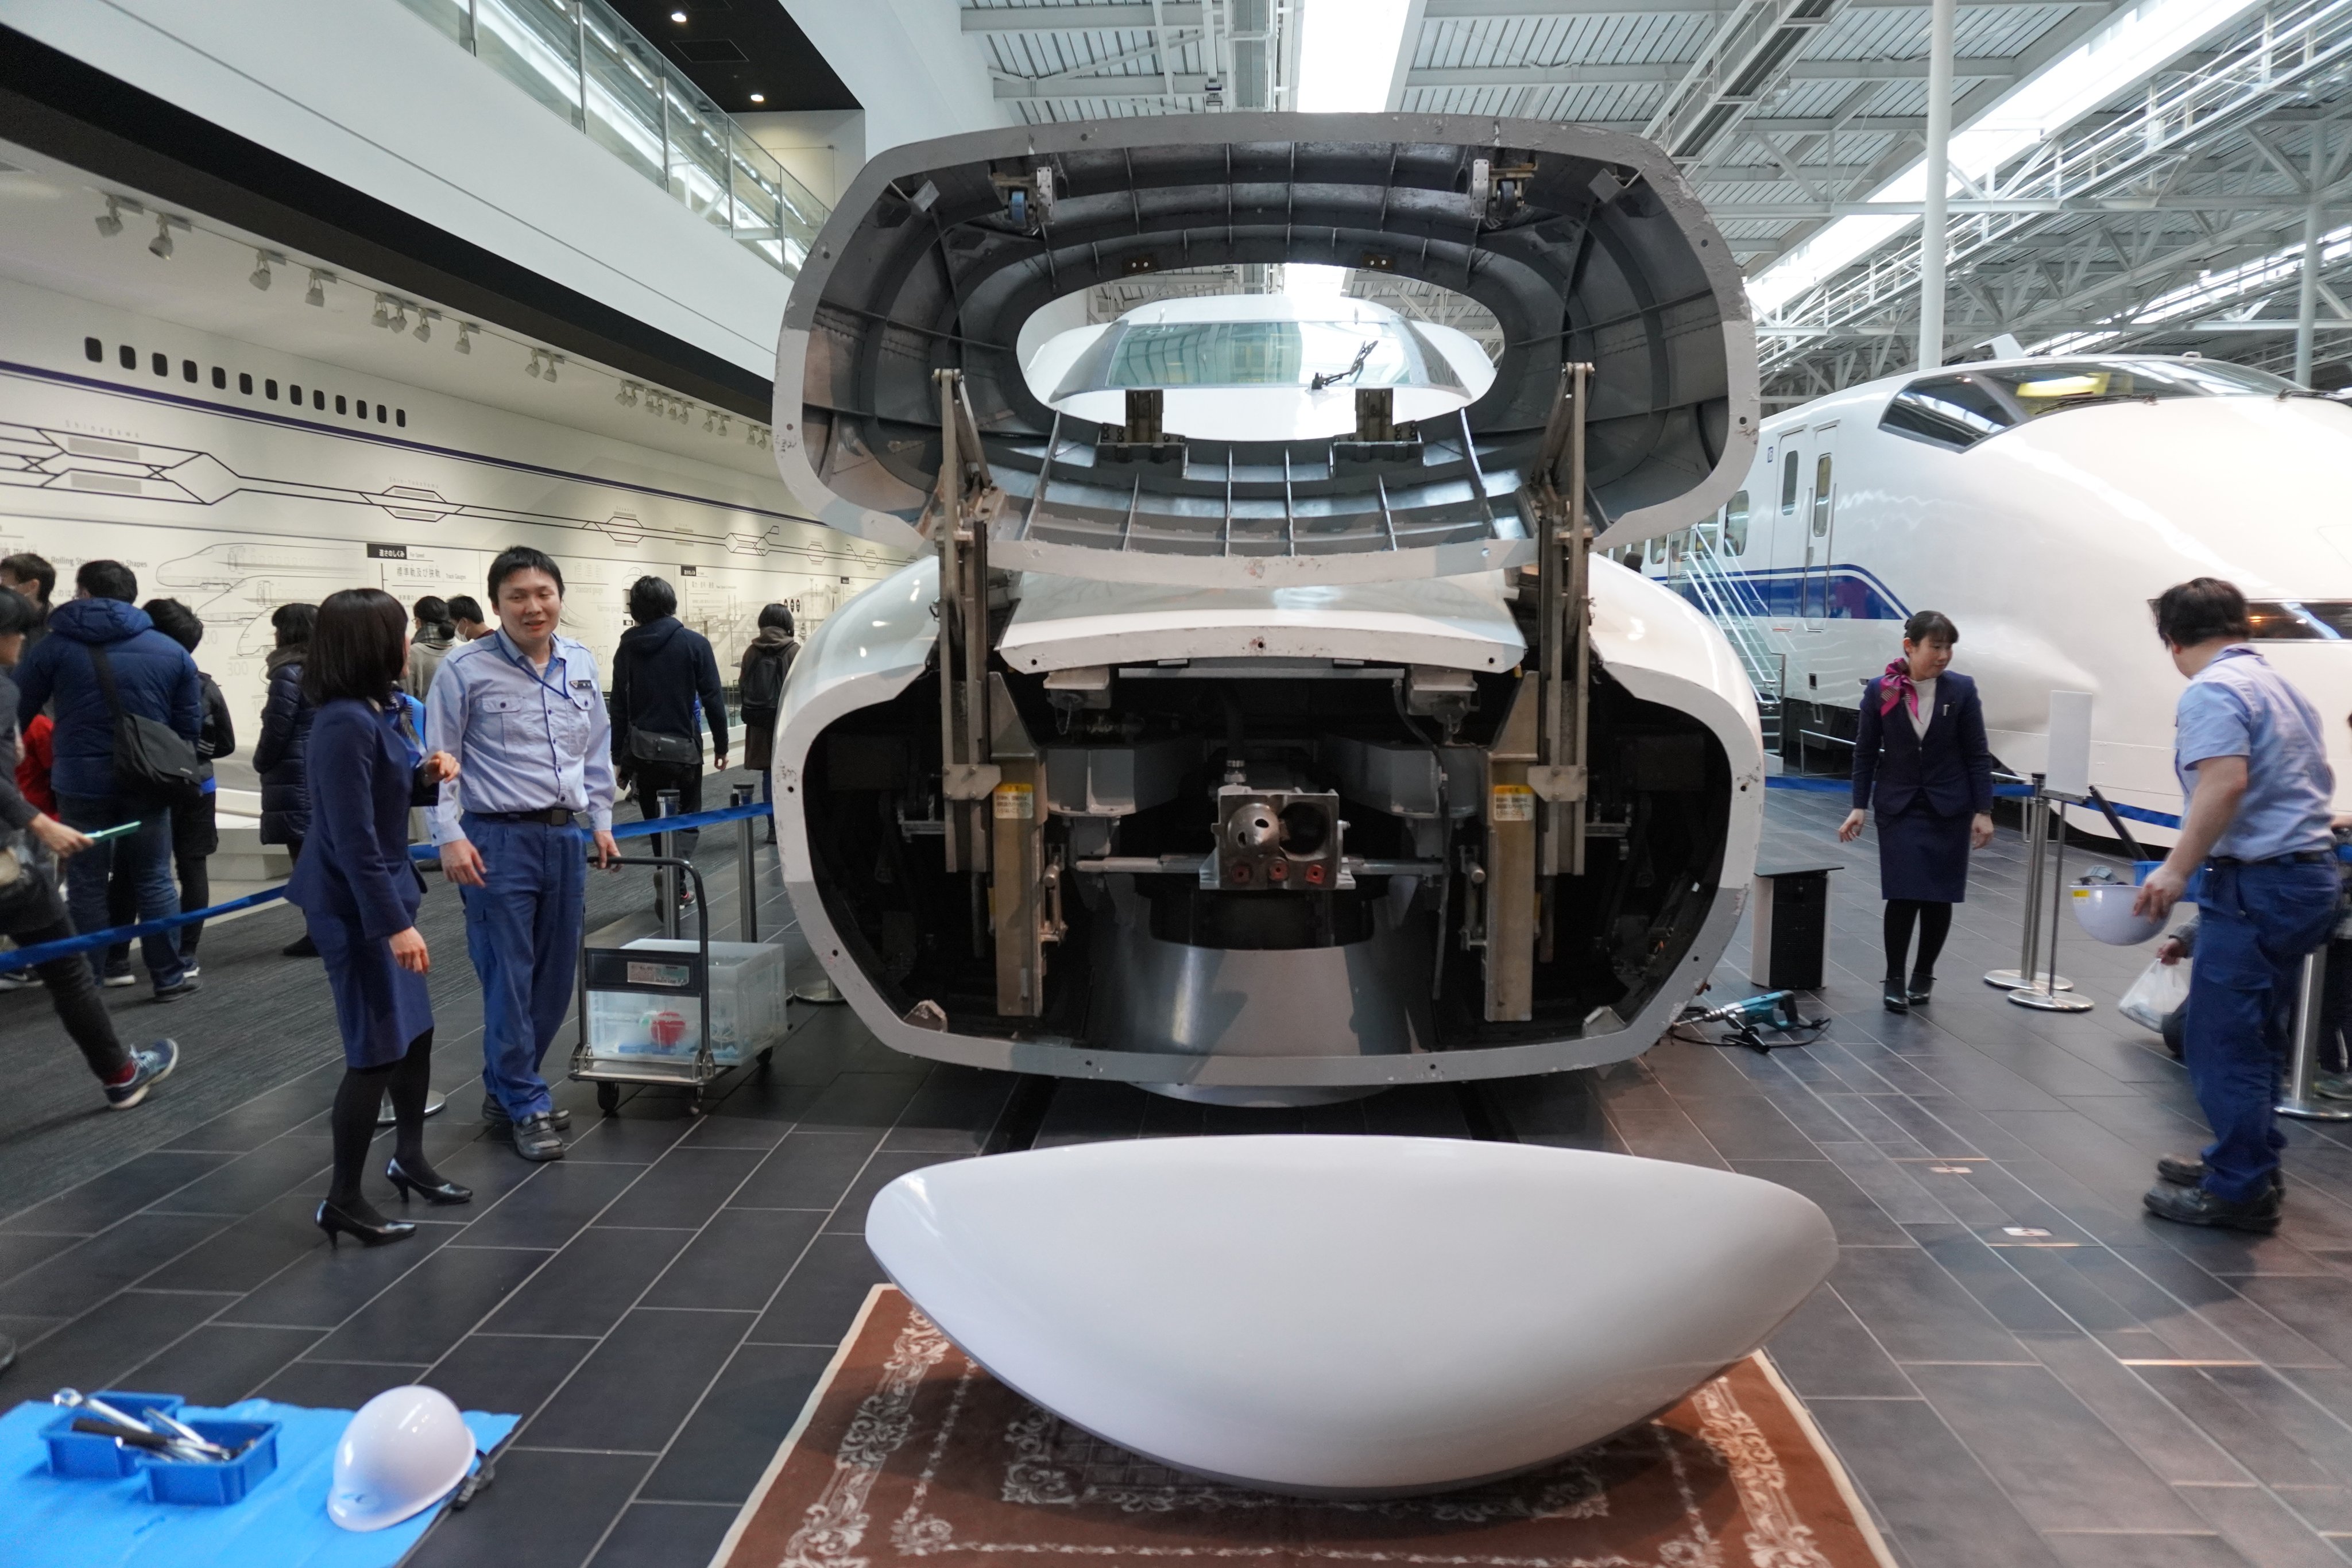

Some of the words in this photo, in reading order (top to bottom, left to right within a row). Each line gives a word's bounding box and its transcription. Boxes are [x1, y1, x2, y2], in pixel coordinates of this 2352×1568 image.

[51, 556, 74, 566] Rolling
[126, 560, 147, 568] Shapes
[227, 661, 248, 676] 300
